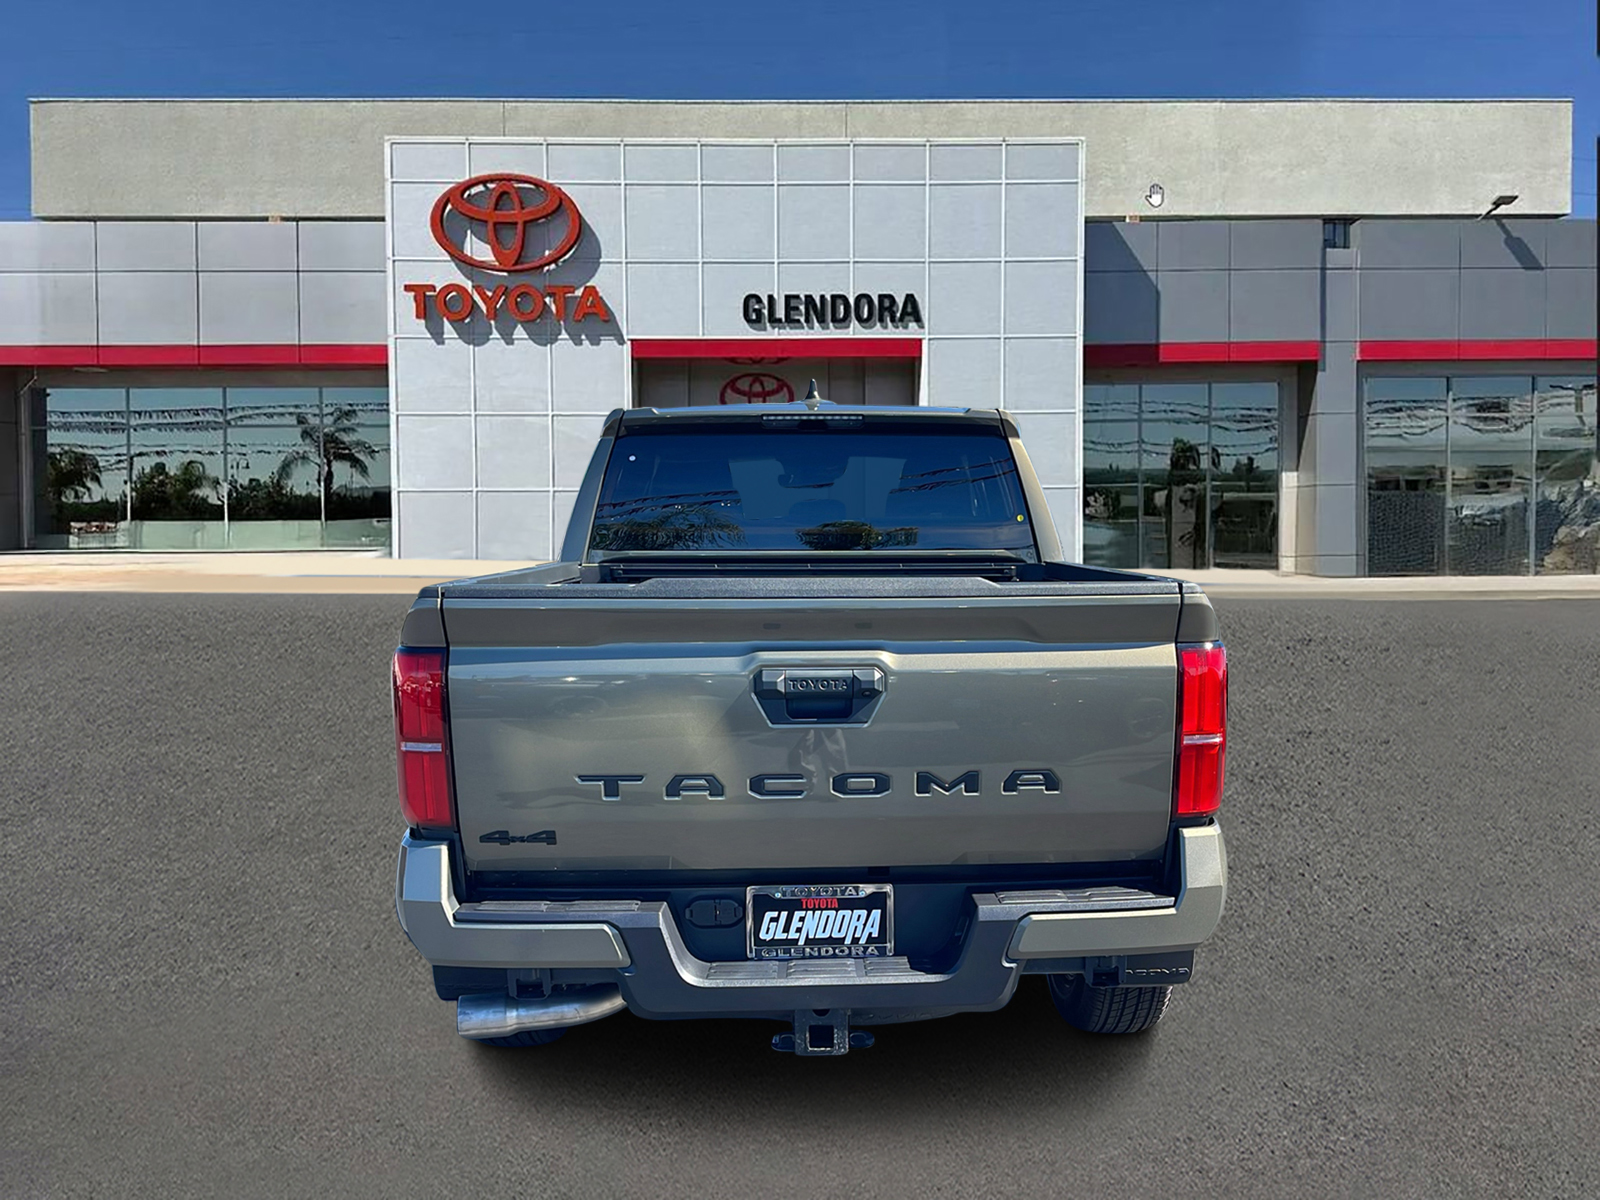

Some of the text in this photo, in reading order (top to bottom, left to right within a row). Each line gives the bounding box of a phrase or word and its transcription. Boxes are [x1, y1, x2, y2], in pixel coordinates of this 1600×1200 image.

[404, 284, 609, 322] TOYOTA
[742, 293, 922, 324] GLENDORA
[787, 680, 848, 691] TOYOTA
[573, 769, 1063, 801] TACOMA
[781, 886, 857, 897] TOYOTA
[801, 898, 838, 909] TOYOTA
[759, 909, 882, 946] GLENDORA
[761, 946, 880, 957] GLENDORA
